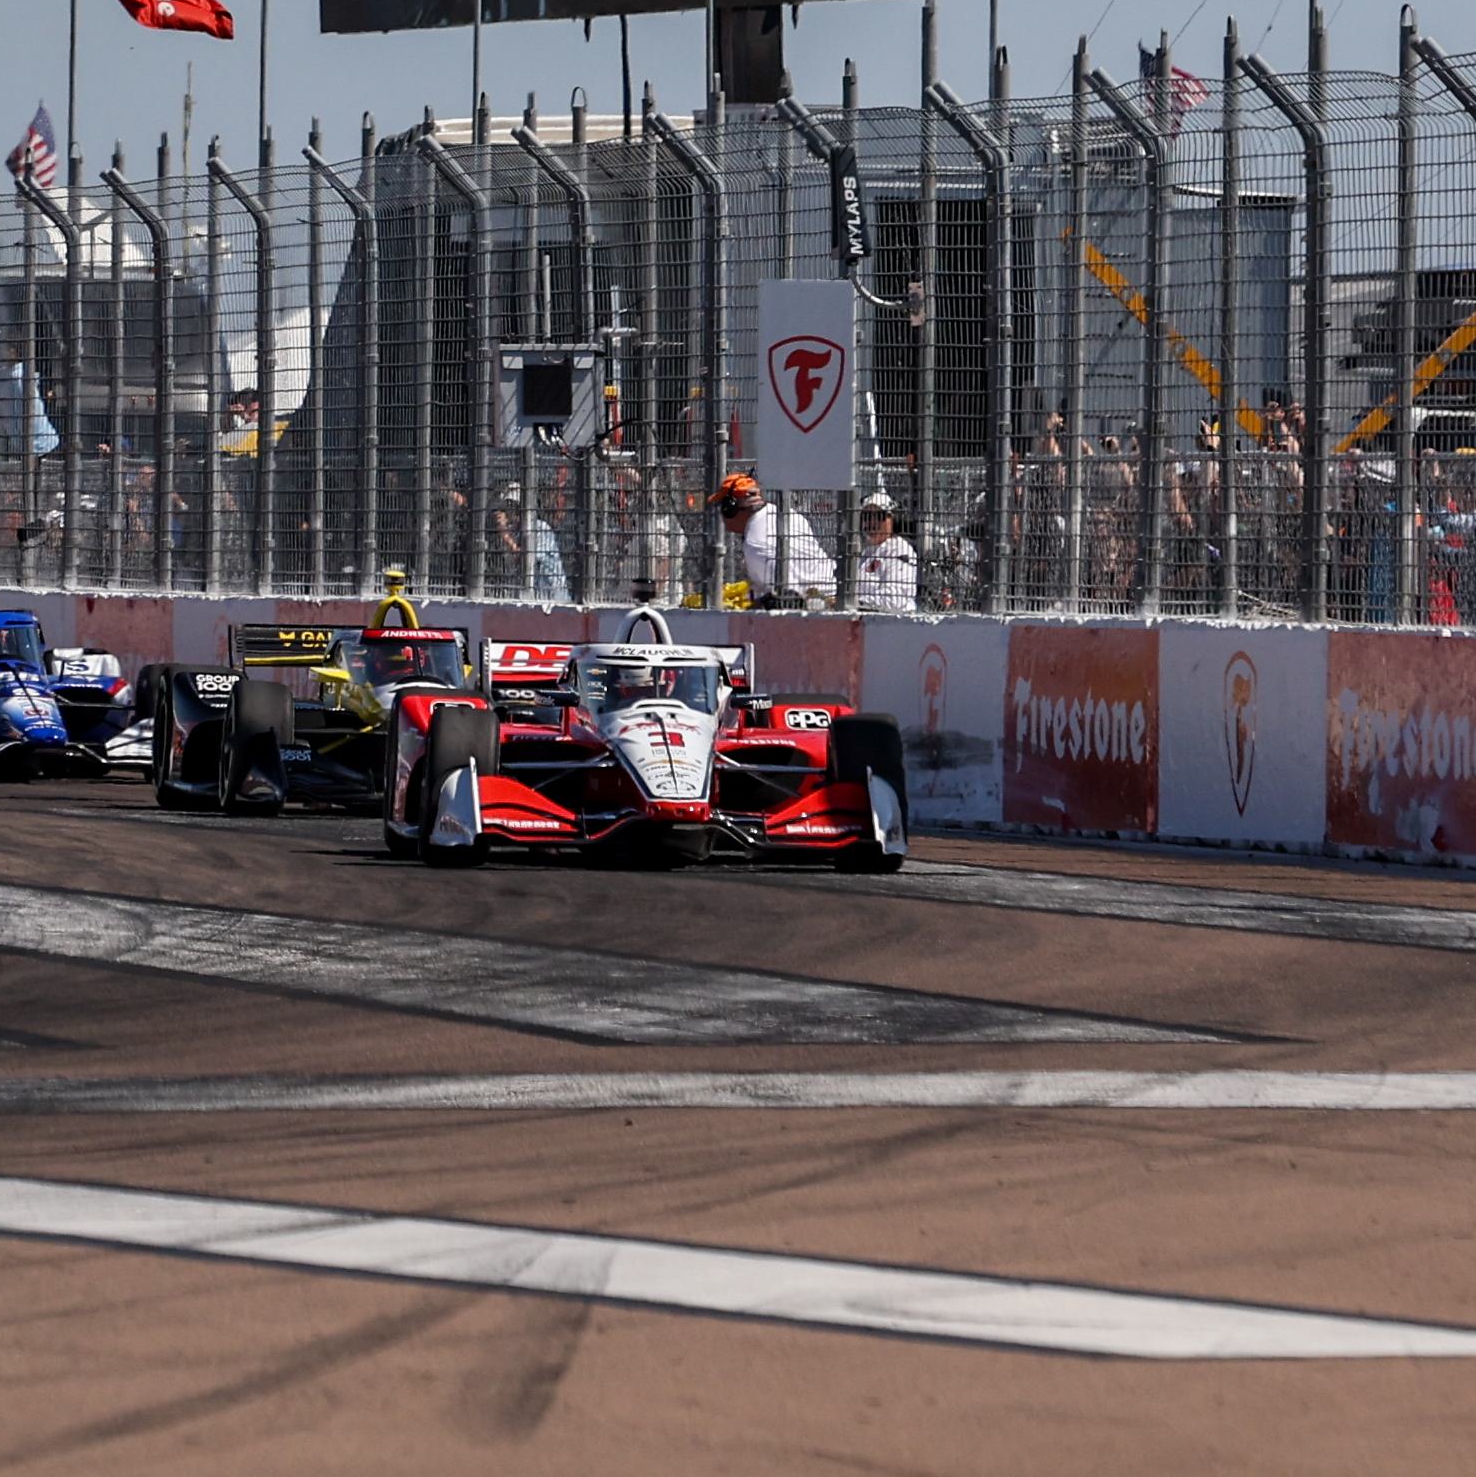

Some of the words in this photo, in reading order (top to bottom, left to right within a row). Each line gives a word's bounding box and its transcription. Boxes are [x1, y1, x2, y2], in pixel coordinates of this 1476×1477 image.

[842, 176, 865, 255] MYLAPS
[784, 348, 832, 414] F
[195, 674, 240, 683] GROUP
[787, 710, 830, 729] PPG
[1013, 675, 1146, 774] Firestone
[1338, 687, 1476, 791] Fireston
